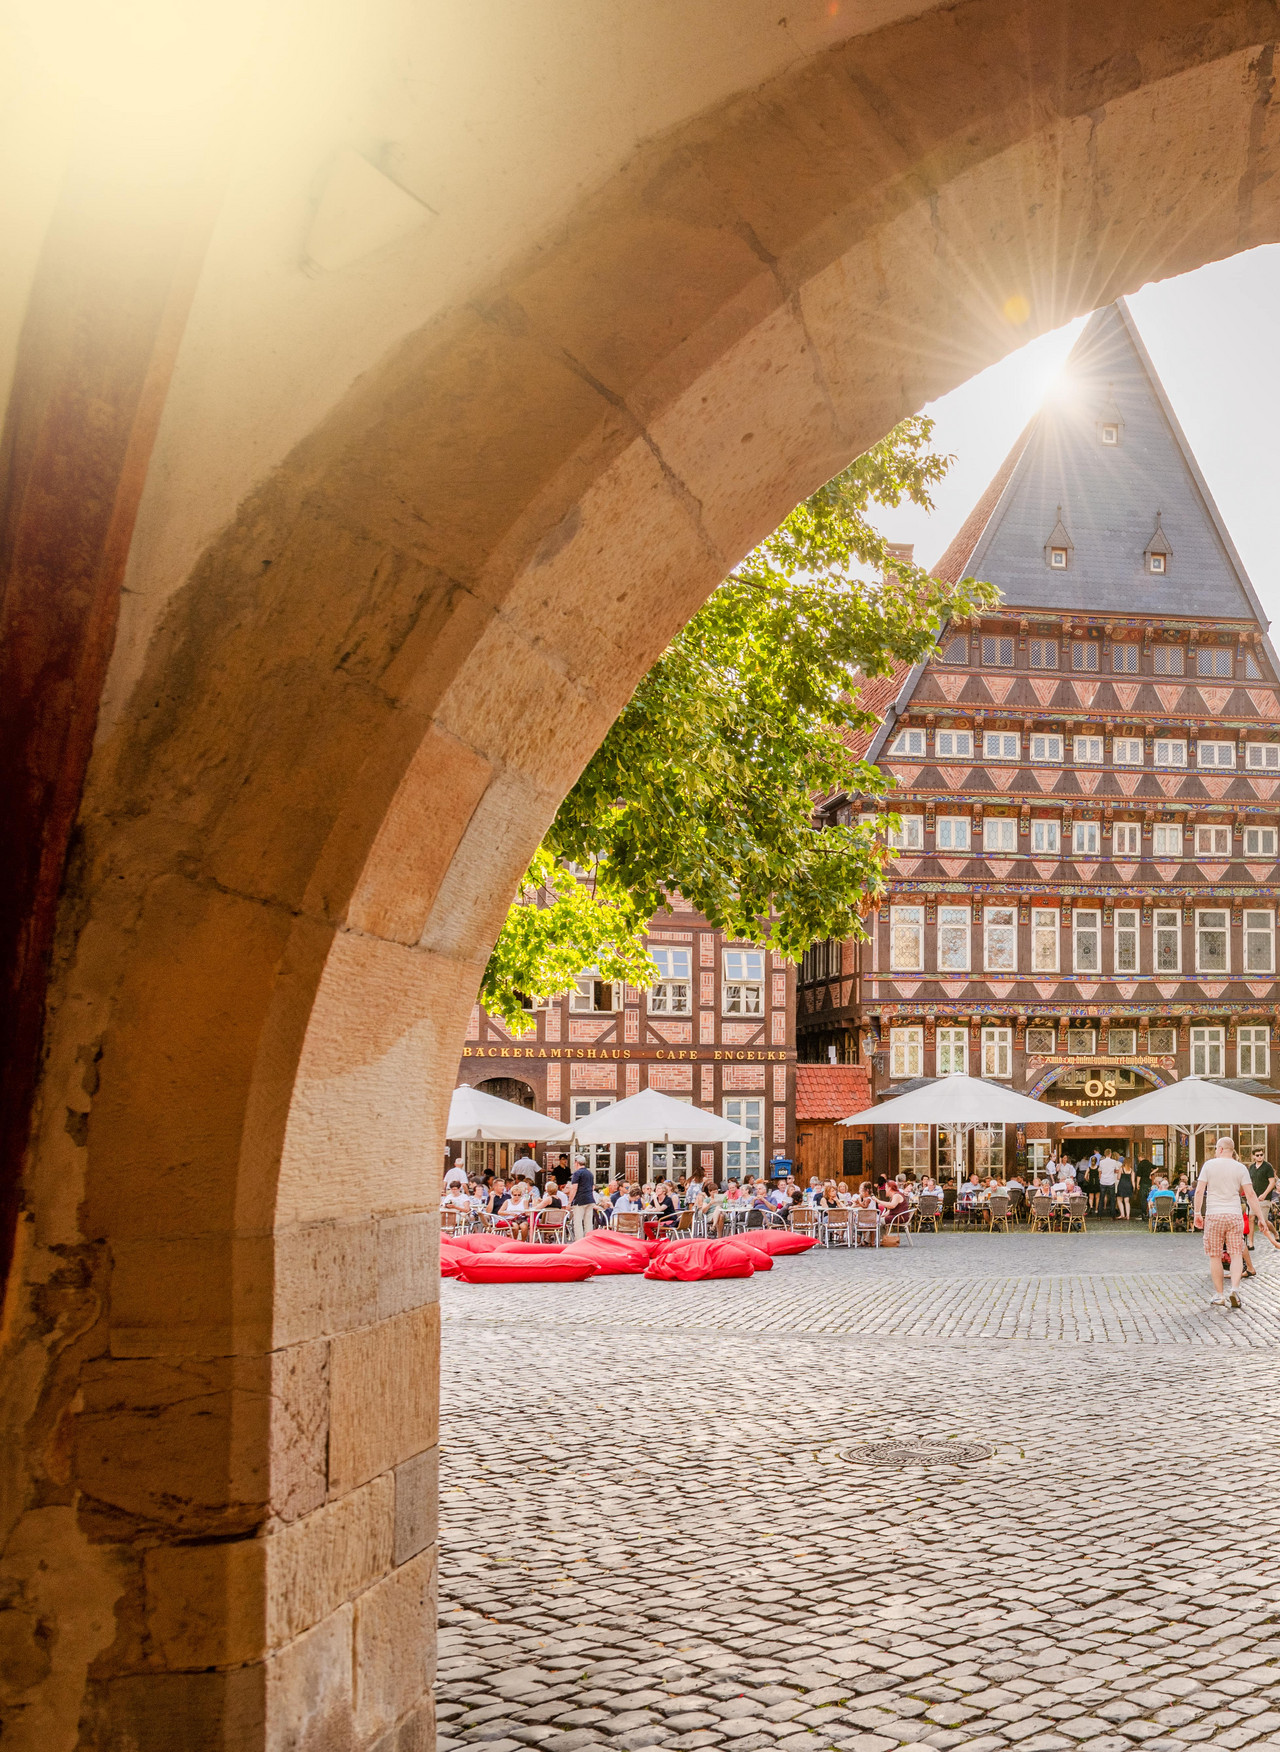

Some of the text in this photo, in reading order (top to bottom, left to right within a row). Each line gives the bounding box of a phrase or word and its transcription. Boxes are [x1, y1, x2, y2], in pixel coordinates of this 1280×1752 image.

[463, 1047, 787, 1060] BÄCKERAMTSHAUS CAFE ENGELKE
[1084, 1080, 1117, 1098] OS
[1060, 1099, 1074, 1107] Das
